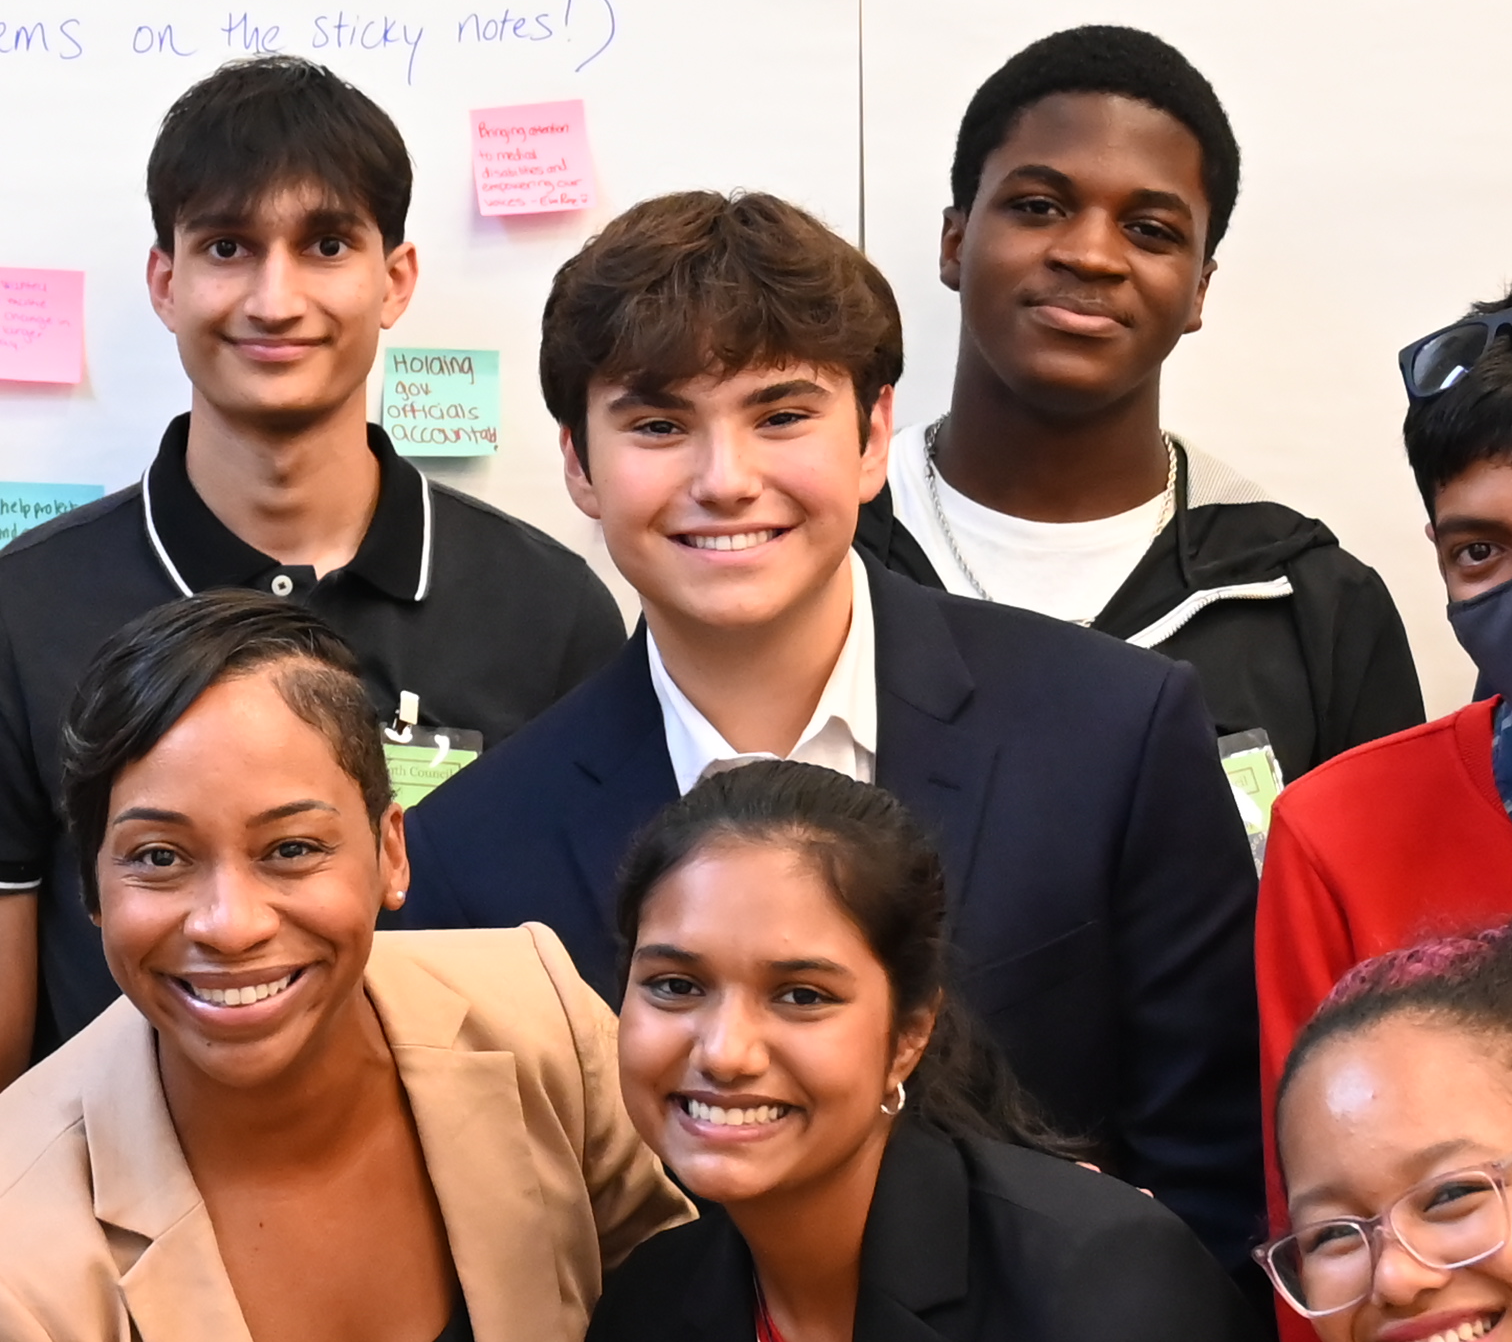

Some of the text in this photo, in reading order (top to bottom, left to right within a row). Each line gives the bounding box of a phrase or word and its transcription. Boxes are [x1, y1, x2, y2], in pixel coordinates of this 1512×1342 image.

[132, 21, 196, 56] on
[220, 11, 280, 54] the
[312, 10, 423, 85] sticky
[393, 353, 475, 385] Holding
[387, 402, 479, 420] officials
[0, 498, 31, 519] help
